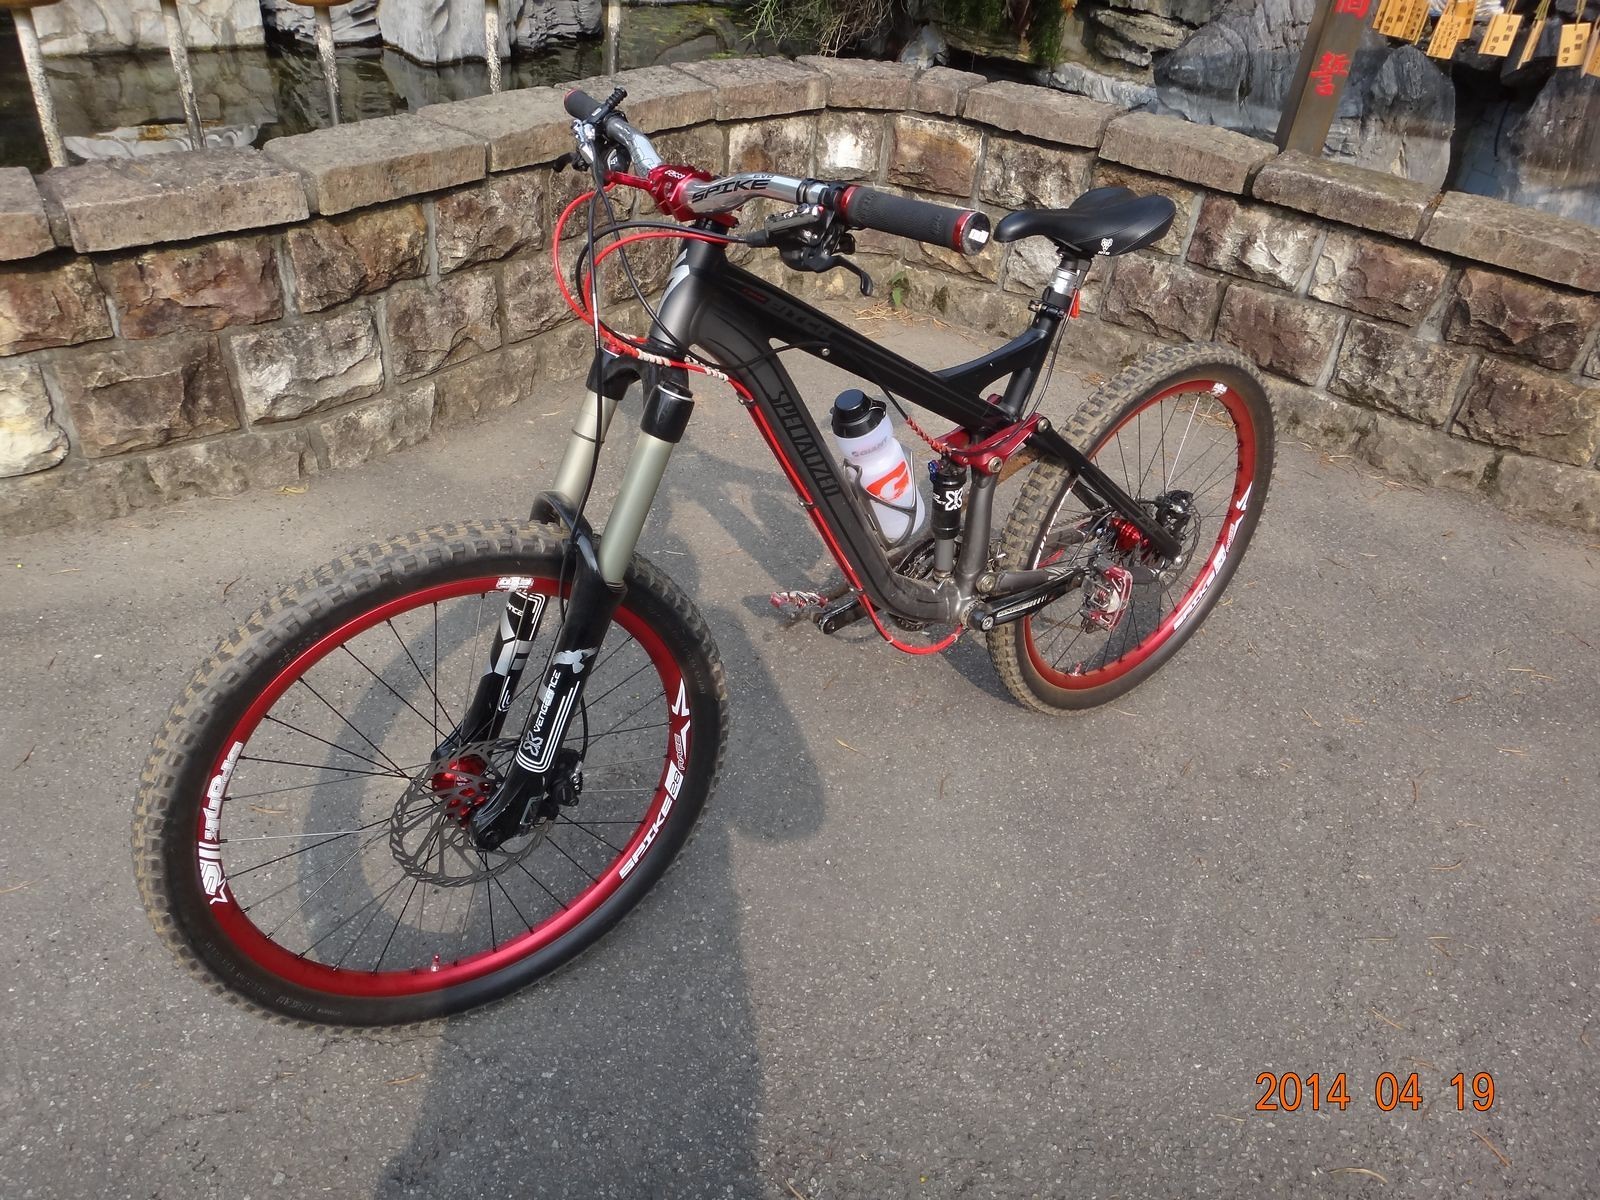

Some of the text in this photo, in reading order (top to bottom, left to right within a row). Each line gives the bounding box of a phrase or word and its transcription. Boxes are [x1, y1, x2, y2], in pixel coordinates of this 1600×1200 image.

[691, 179, 771, 204] SPIKE
[770, 390, 841, 497] SPECIALIZED
[533, 669, 562, 733] VENGEANCE
[618, 799, 673, 880] SPIKE
